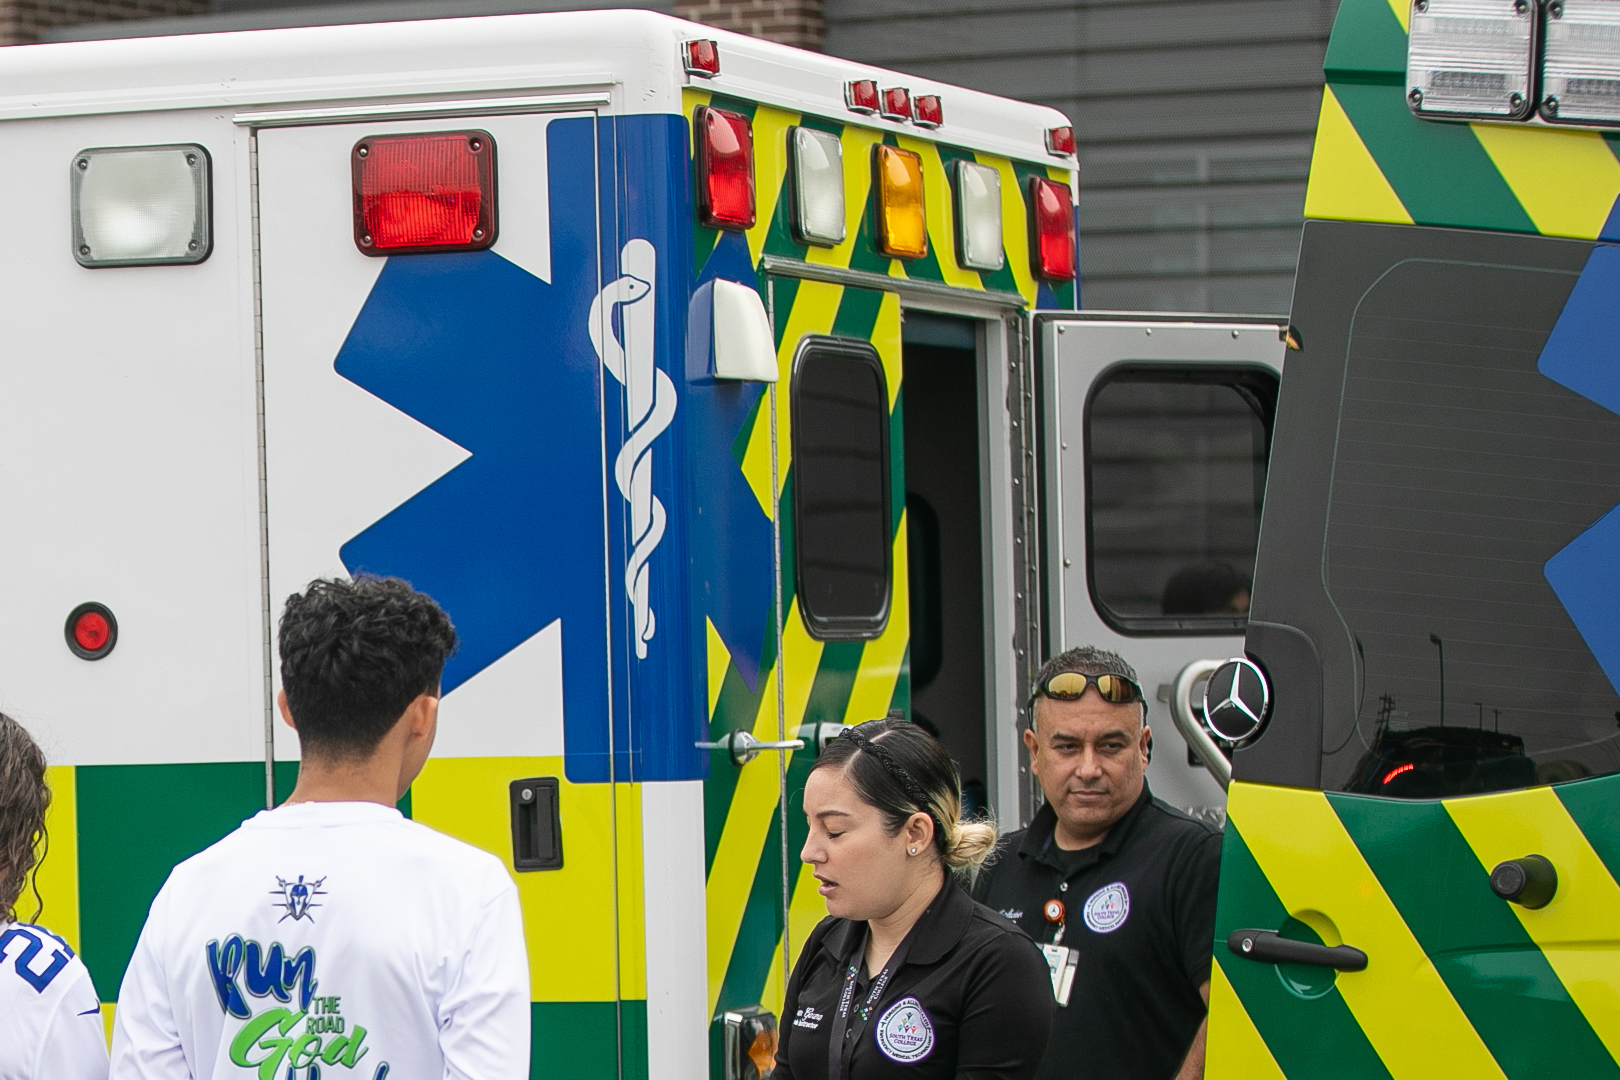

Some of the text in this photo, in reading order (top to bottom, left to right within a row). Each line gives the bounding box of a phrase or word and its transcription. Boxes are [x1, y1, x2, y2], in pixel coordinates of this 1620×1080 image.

[206, 933, 318, 1019] Run
[313, 995, 341, 1015] THE
[306, 1015, 345, 1035] ROAD
